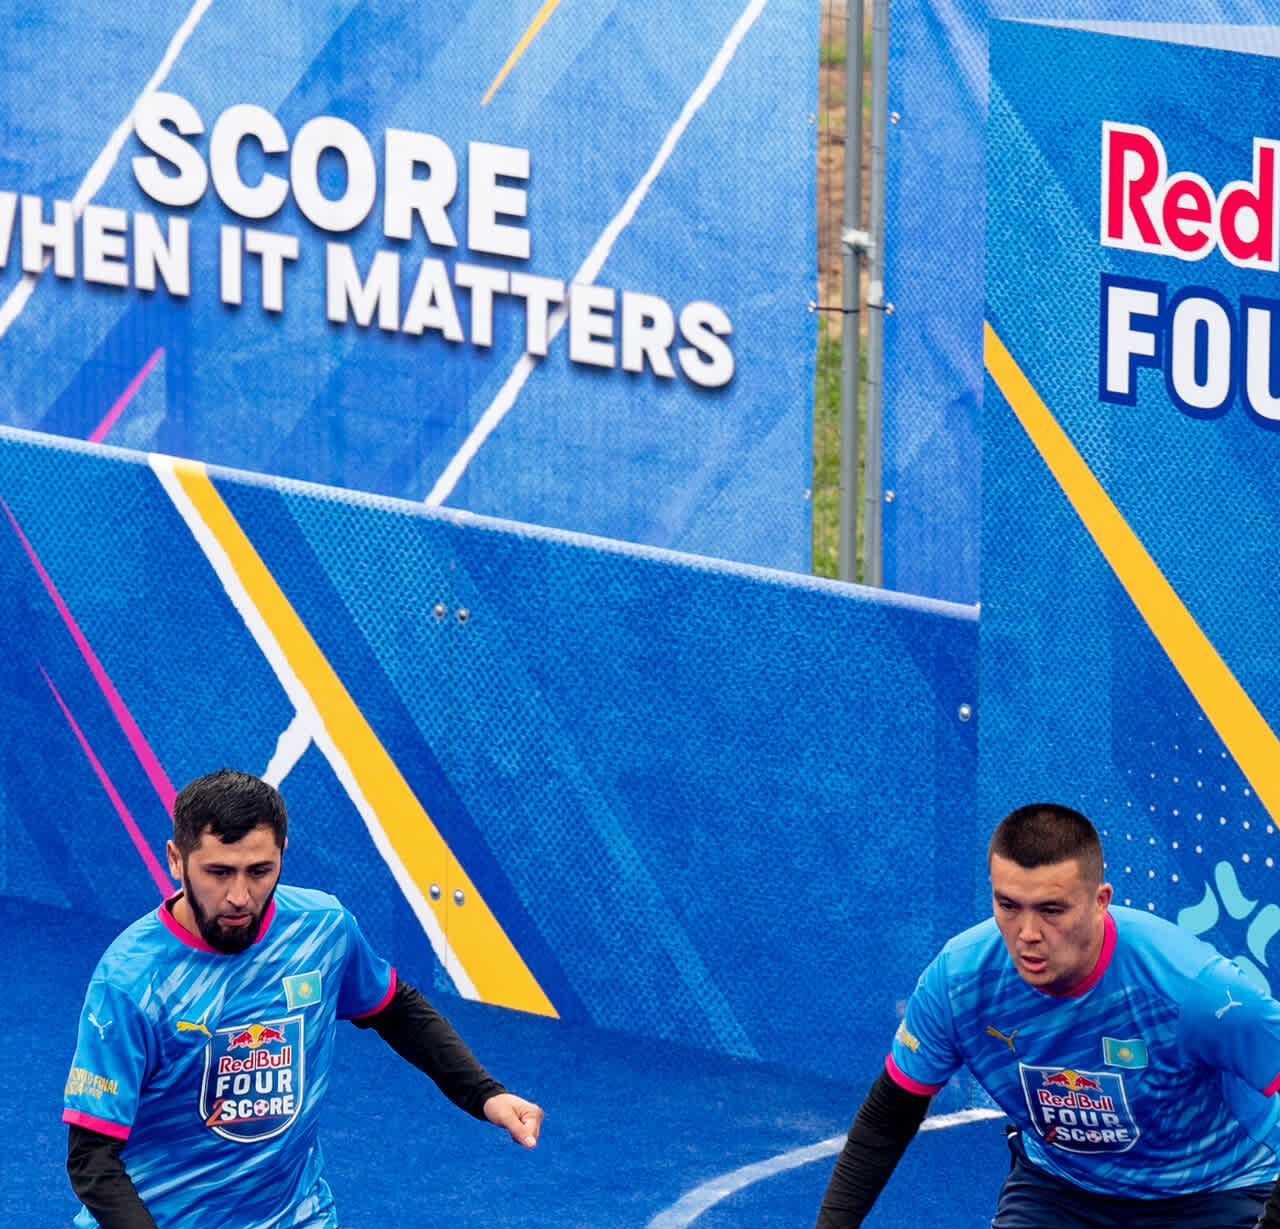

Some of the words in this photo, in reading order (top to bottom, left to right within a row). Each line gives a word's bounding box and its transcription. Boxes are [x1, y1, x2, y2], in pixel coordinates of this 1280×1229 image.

[131, 91, 531, 260] SCORE
[219, 225, 300, 313] IT
[325, 243, 737, 389] MATTERS
[216, 1069, 293, 1098] FOUR
